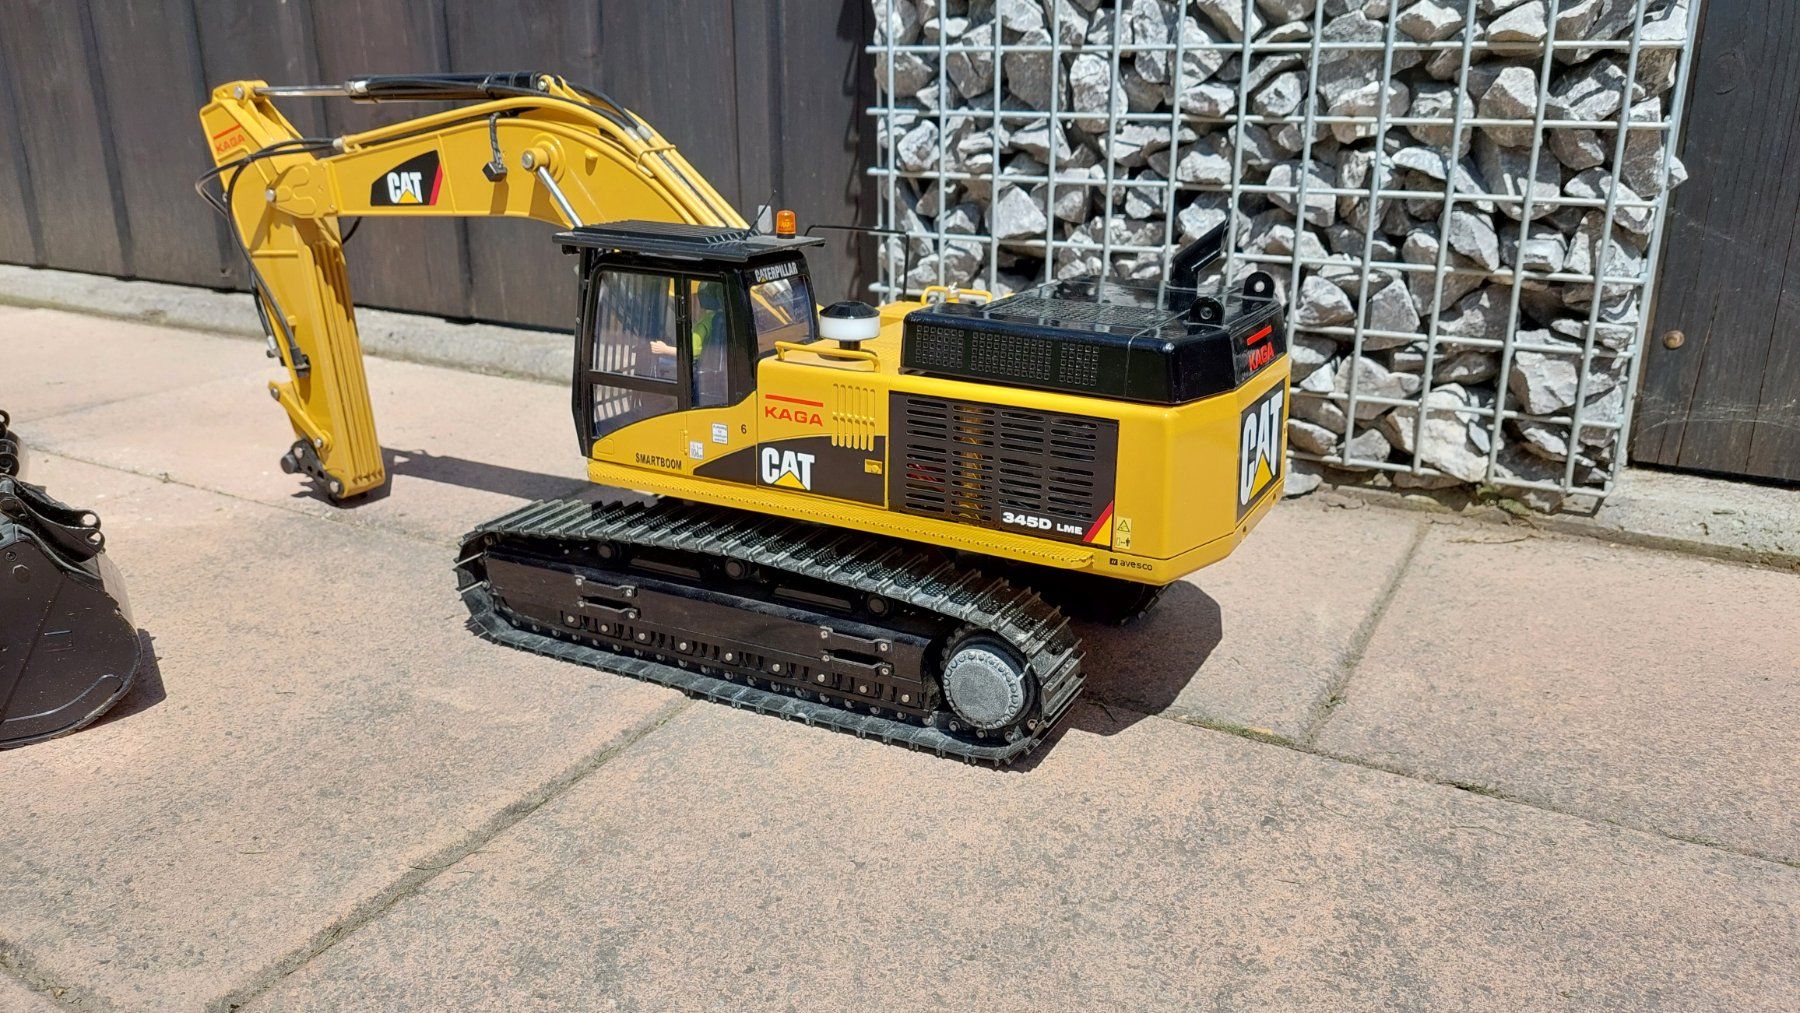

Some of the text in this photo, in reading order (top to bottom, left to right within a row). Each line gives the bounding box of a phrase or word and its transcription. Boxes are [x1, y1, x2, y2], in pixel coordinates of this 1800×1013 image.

[215, 134, 245, 153] KAGA
[386, 171, 422, 204] CAT
[754, 261, 799, 282] CATERPILLAR
[1249, 345, 1274, 371] KAGA
[765, 405, 824, 427] KAGA
[740, 424, 747, 434] 6
[1240, 389, 1283, 506] CAT
[635, 452, 682, 471] SMARTBOOM
[761, 446, 815, 491] CAT
[1002, 511, 1083, 536] 345D LME
[1119, 560, 1153, 571] avesco
